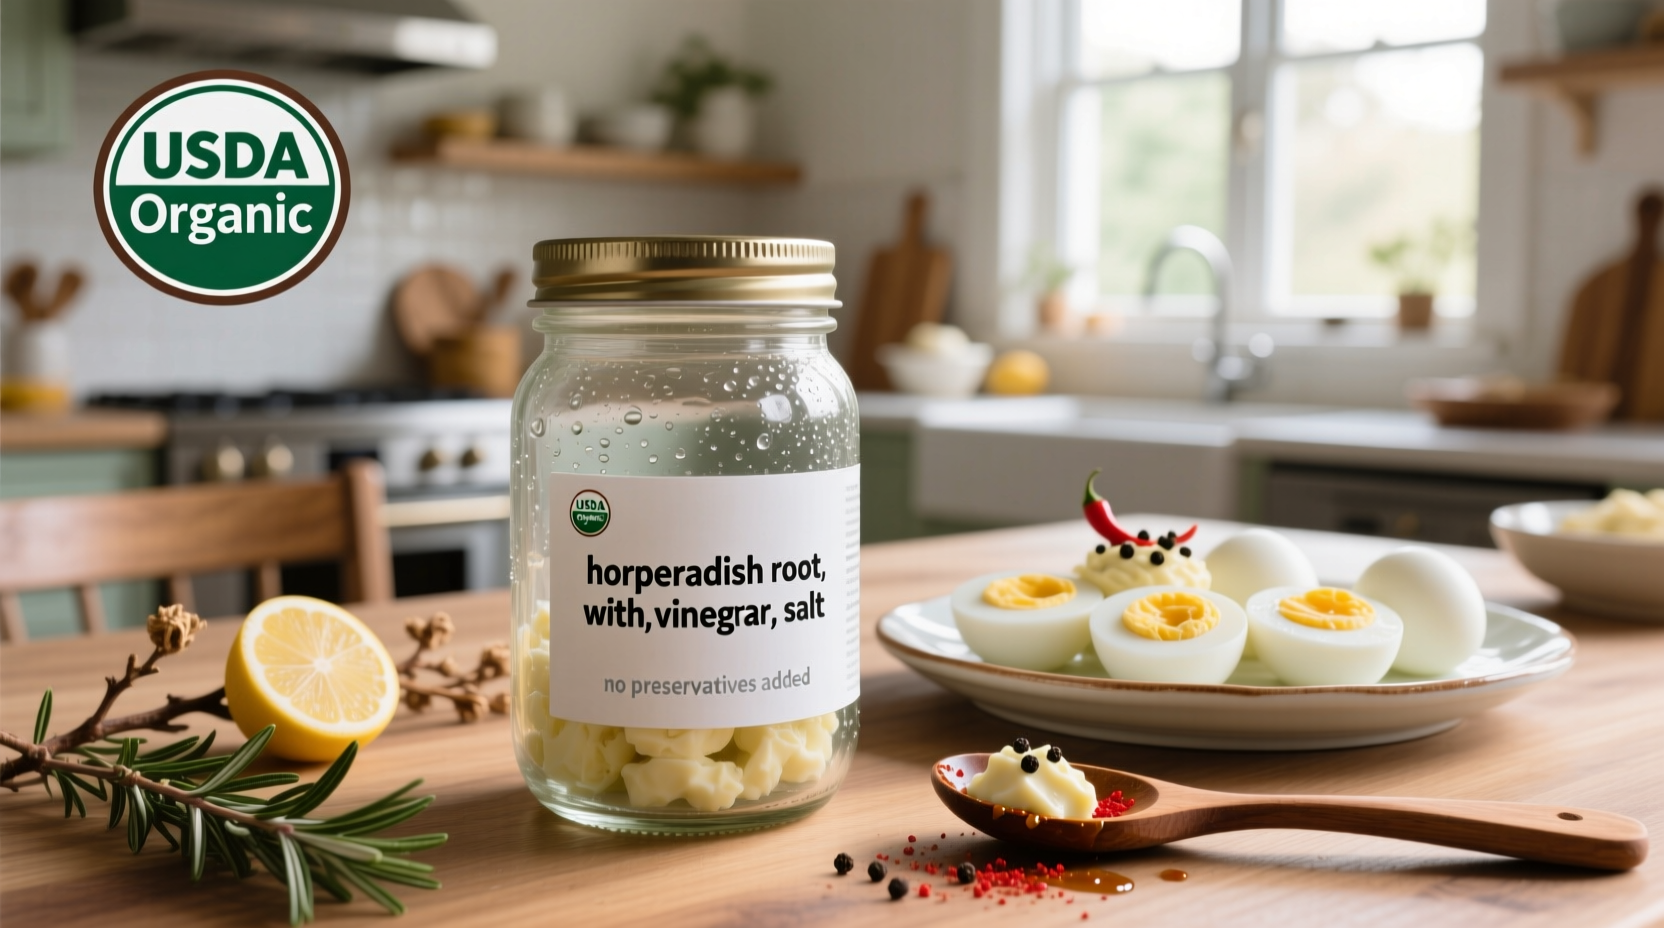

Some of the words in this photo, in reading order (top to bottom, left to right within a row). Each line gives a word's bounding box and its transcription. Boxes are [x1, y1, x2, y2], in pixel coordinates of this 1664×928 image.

[576, 499, 606, 511] USDA
[587, 554, 763, 594] horperadish
[771, 553, 826, 581] root,
[783, 591, 826, 622] salt
[604, 676, 626, 693] no
[631, 674, 756, 698] preservatives
[761, 666, 811, 691] added
